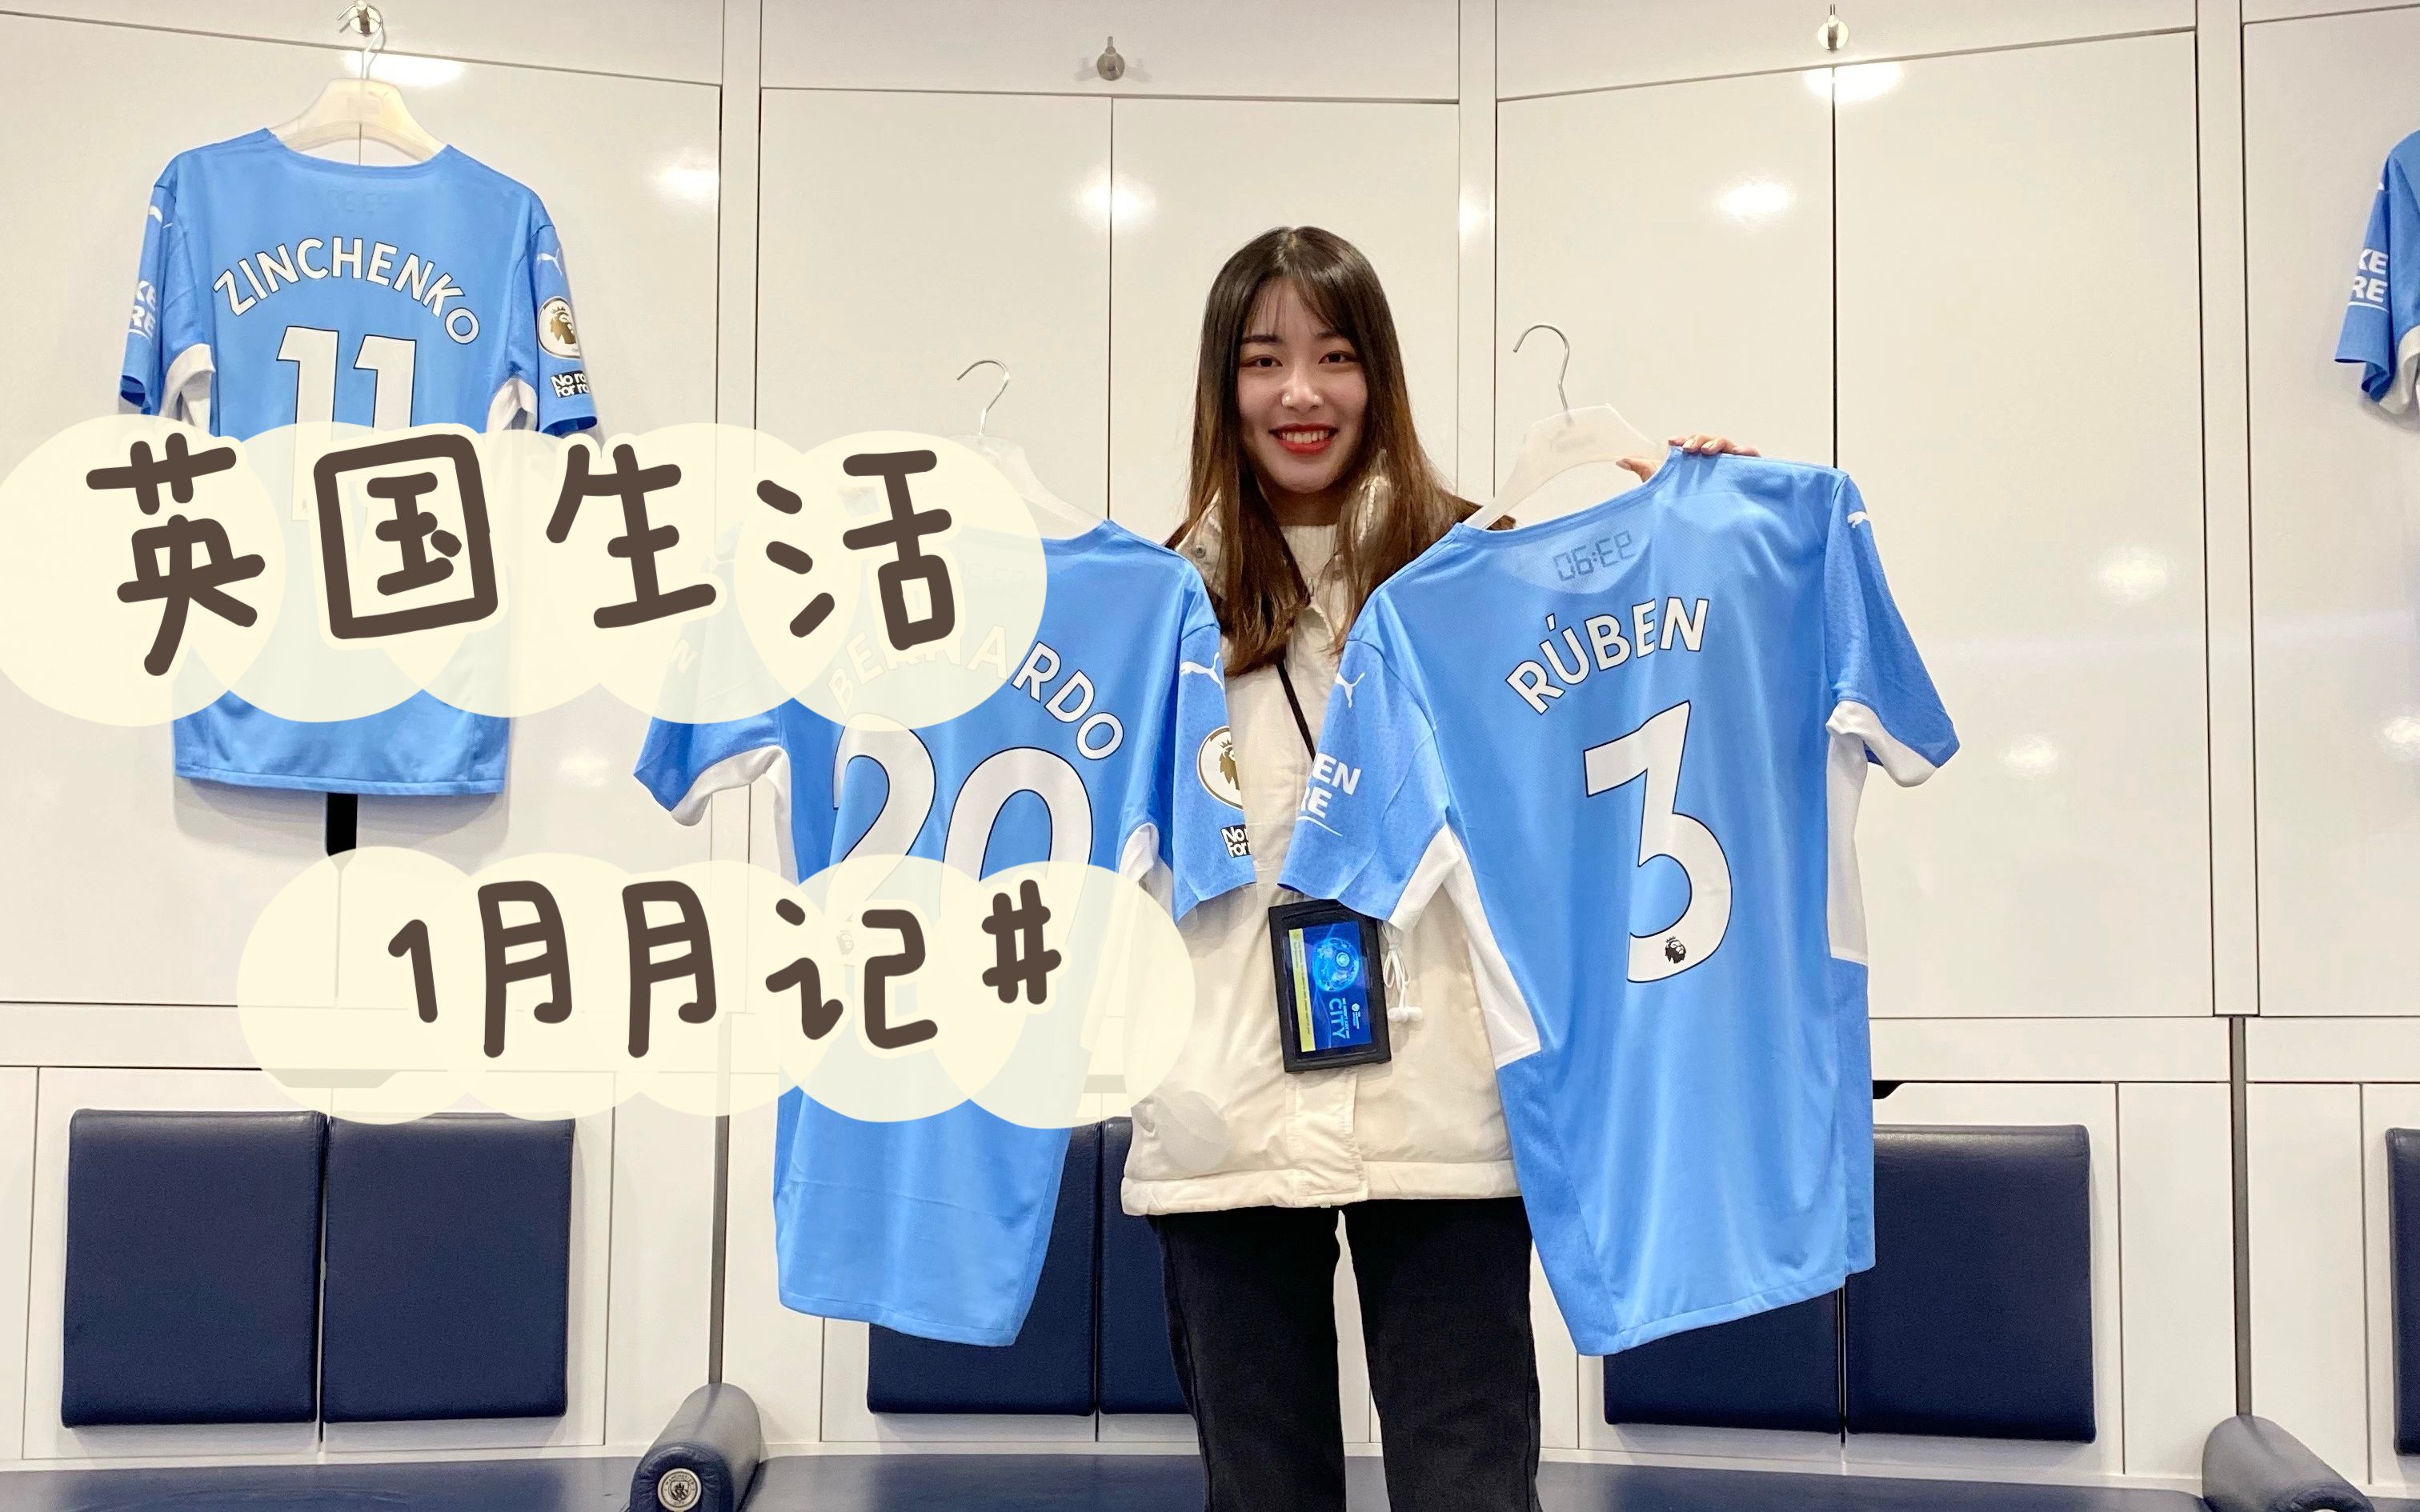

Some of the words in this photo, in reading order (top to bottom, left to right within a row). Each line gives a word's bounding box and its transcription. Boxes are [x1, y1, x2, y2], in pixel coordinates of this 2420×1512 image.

[212, 236, 481, 345] ZINCHENKO
[551, 373, 573, 386] No
[1505, 596, 1709, 715] RÚBEN
[833, 713, 1094, 966] 20
[1583, 700, 1733, 984] 3
[1328, 998, 1347, 1039] CITY
